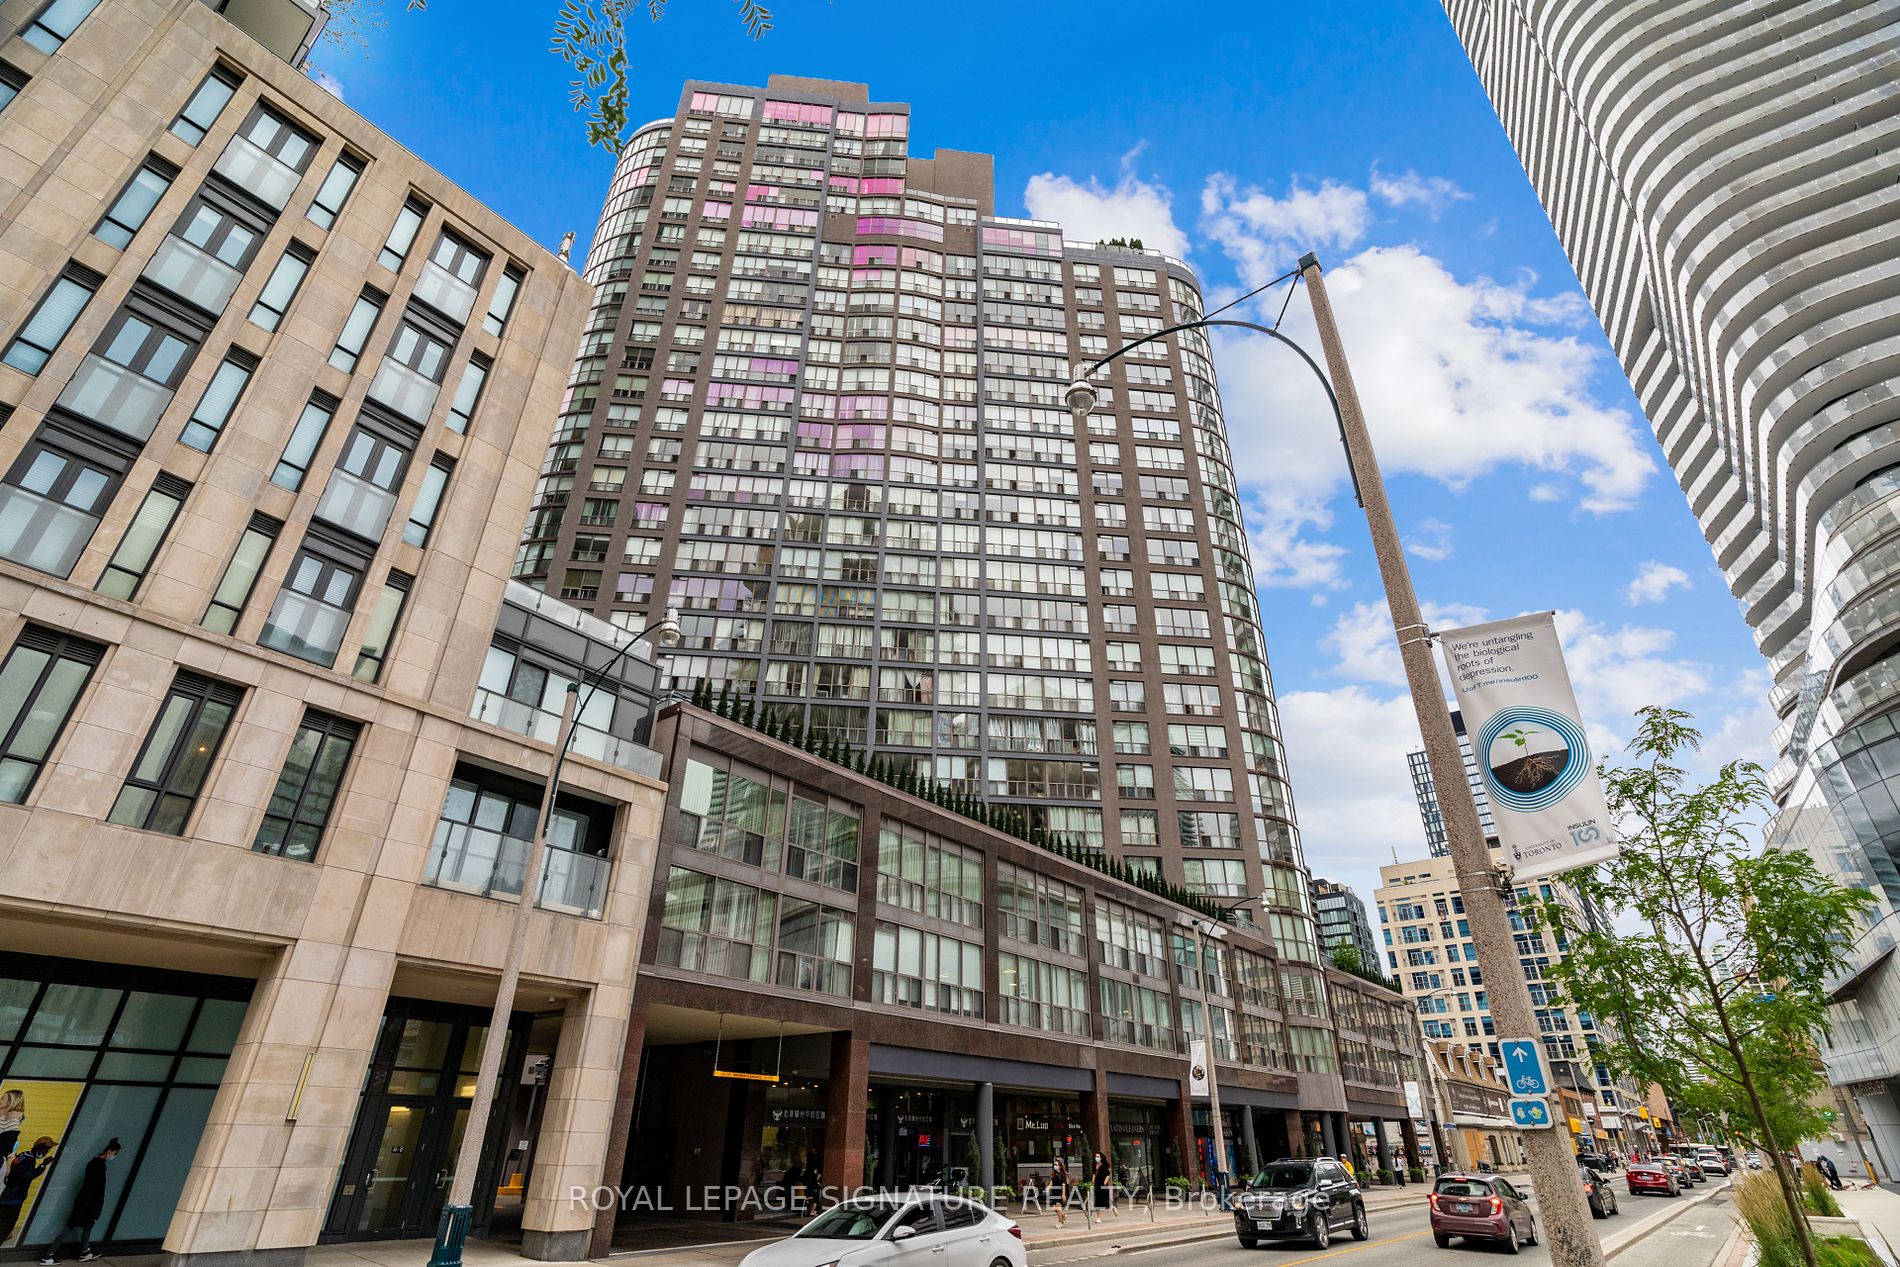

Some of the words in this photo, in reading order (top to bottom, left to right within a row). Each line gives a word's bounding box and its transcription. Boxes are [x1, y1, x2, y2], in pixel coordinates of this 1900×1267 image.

[1452, 641, 1479, 651] We're
[1482, 632, 1534, 647] untangling
[1454, 652, 1469, 661] the
[1473, 643, 1520, 656] biological
[1457, 660, 1481, 671] roots
[1484, 657, 1494, 665] of
[1459, 665, 1515, 681] depression.
[1462, 673, 1539, 693] UofT.me/insulin100
[1567, 818, 1596, 831] INSULIN
[1522, 842, 1562, 859] TORONTO
